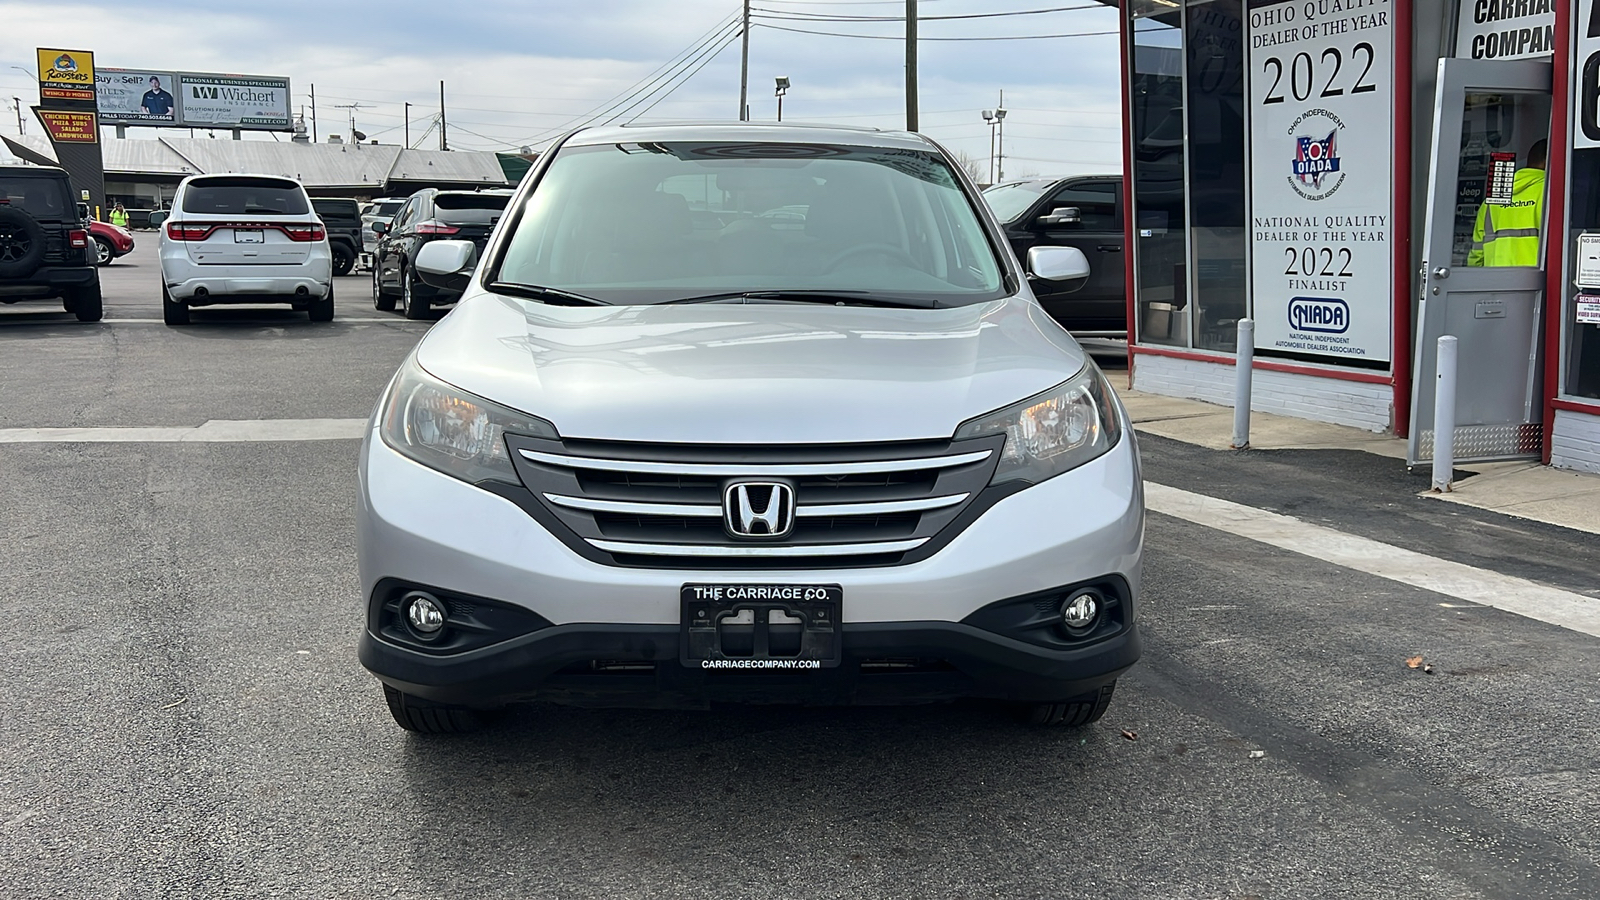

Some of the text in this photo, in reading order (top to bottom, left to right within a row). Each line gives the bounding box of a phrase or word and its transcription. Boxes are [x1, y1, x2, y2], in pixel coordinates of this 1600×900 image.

[1251, 6, 1295, 28] OHIO
[1253, 28, 1299, 48] DEALER
[1302, 24, 1319, 40] OF
[1322, 18, 1348, 36] THE
[1351, 11, 1388, 31] YEAR
[45, 68, 88, 81] Roosters
[95, 76, 112, 84] Buy
[122, 76, 144, 84] Sell?
[1263, 42, 1376, 105] 2022
[220, 88, 276, 102] Wichert
[1287, 108, 1346, 135] OHIO INDEPENDENT
[1298, 160, 1332, 173] OIADA
[1255, 216, 1387, 229] NATIONAL QUALITY
[1256, 232, 1384, 241] DEALER OF THE YEAR
[1284, 247, 1353, 277] 2022
[1289, 280, 1346, 291] FINALIST
[1293, 304, 1343, 326] NIADA
[1315, 336, 1349, 344] INDEPENDENT
[1275, 341, 1366, 355] AUTOMOBILE DEALERS ASSOCIATION
[694, 588, 830, 600] THE CARRIAGE CO.
[702, 660, 820, 668] CARRIAGECOMPANY.COM
